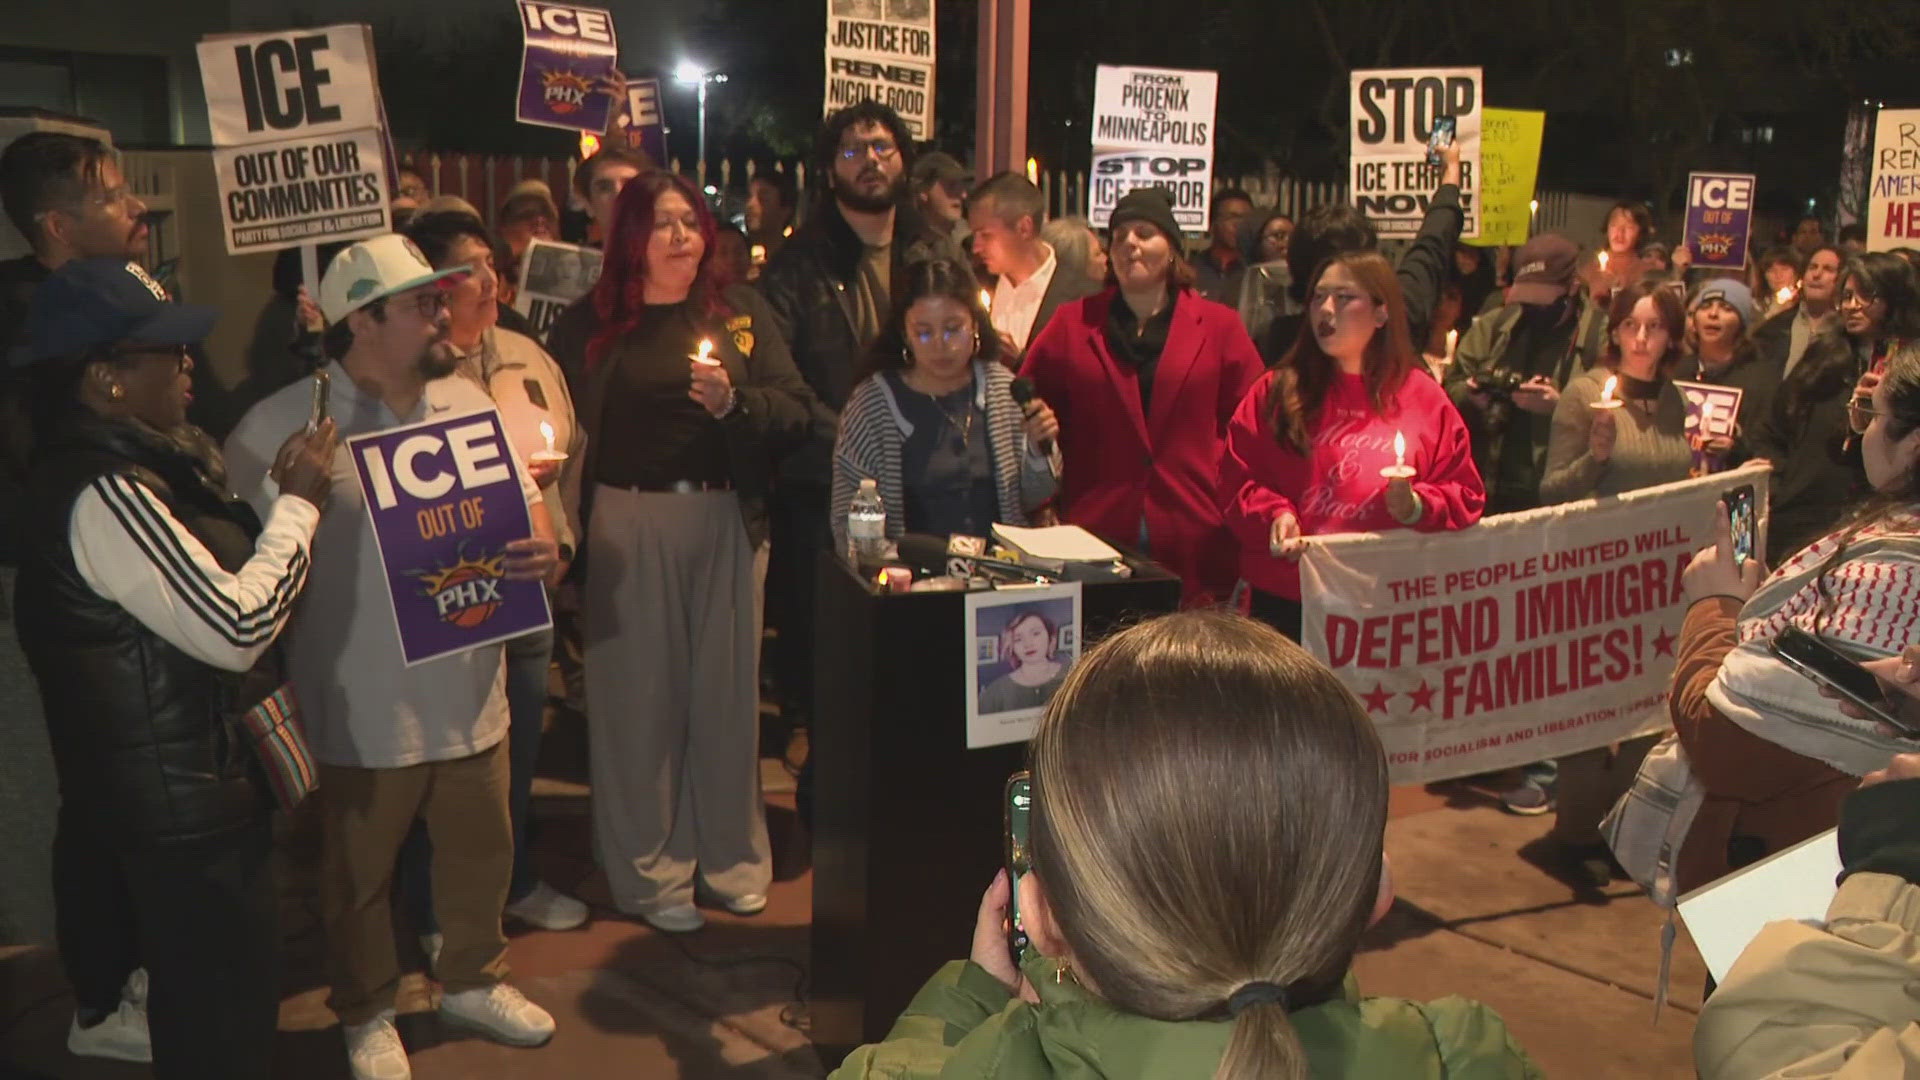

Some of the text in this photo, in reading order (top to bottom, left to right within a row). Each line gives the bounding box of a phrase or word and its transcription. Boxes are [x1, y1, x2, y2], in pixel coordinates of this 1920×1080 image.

[526, 4, 611, 42] ICE
[832, 20, 931, 57] JUSTICE FOR
[234, 34, 342, 133] ICE
[831, 58, 926, 88] RENEE
[1133, 73, 1182, 86] FROM
[545, 86, 585, 106] PHX
[621, 87, 659, 127] E
[829, 78, 925, 116] NICOLE GOOD
[1122, 84, 1190, 112] PHOENIX
[1358, 77, 1474, 144] STOP
[1098, 115, 1207, 147] MINNEAPOLIS
[1144, 111, 1167, 121] TO
[234, 140, 360, 188] OUT OF OUR
[1097, 157, 1206, 178] STOP
[1356, 162, 1387, 191] ICE
[227, 172, 380, 223] COMMUNITIES
[1095, 178, 1126, 206] ICE
[1692, 178, 1750, 210] ICE
[1312, 419, 1392, 453] Moon
[362, 420, 511, 511] ICE
[416, 496, 486, 541] OUT OF
[1302, 485, 1381, 521] Back
[1387, 525, 1691, 604] THE PEOPLE UNITED WILL
[435, 578, 502, 617] PHX
[1325, 596, 1499, 670] DEFEND
[1441, 623, 1643, 720] FAMILIES!
[1389, 752, 1419, 765] FOR
[1424, 735, 1501, 762] SOCIALISM
[1506, 729, 1533, 747] AND
[1537, 708, 1617, 736] LIBERATION
